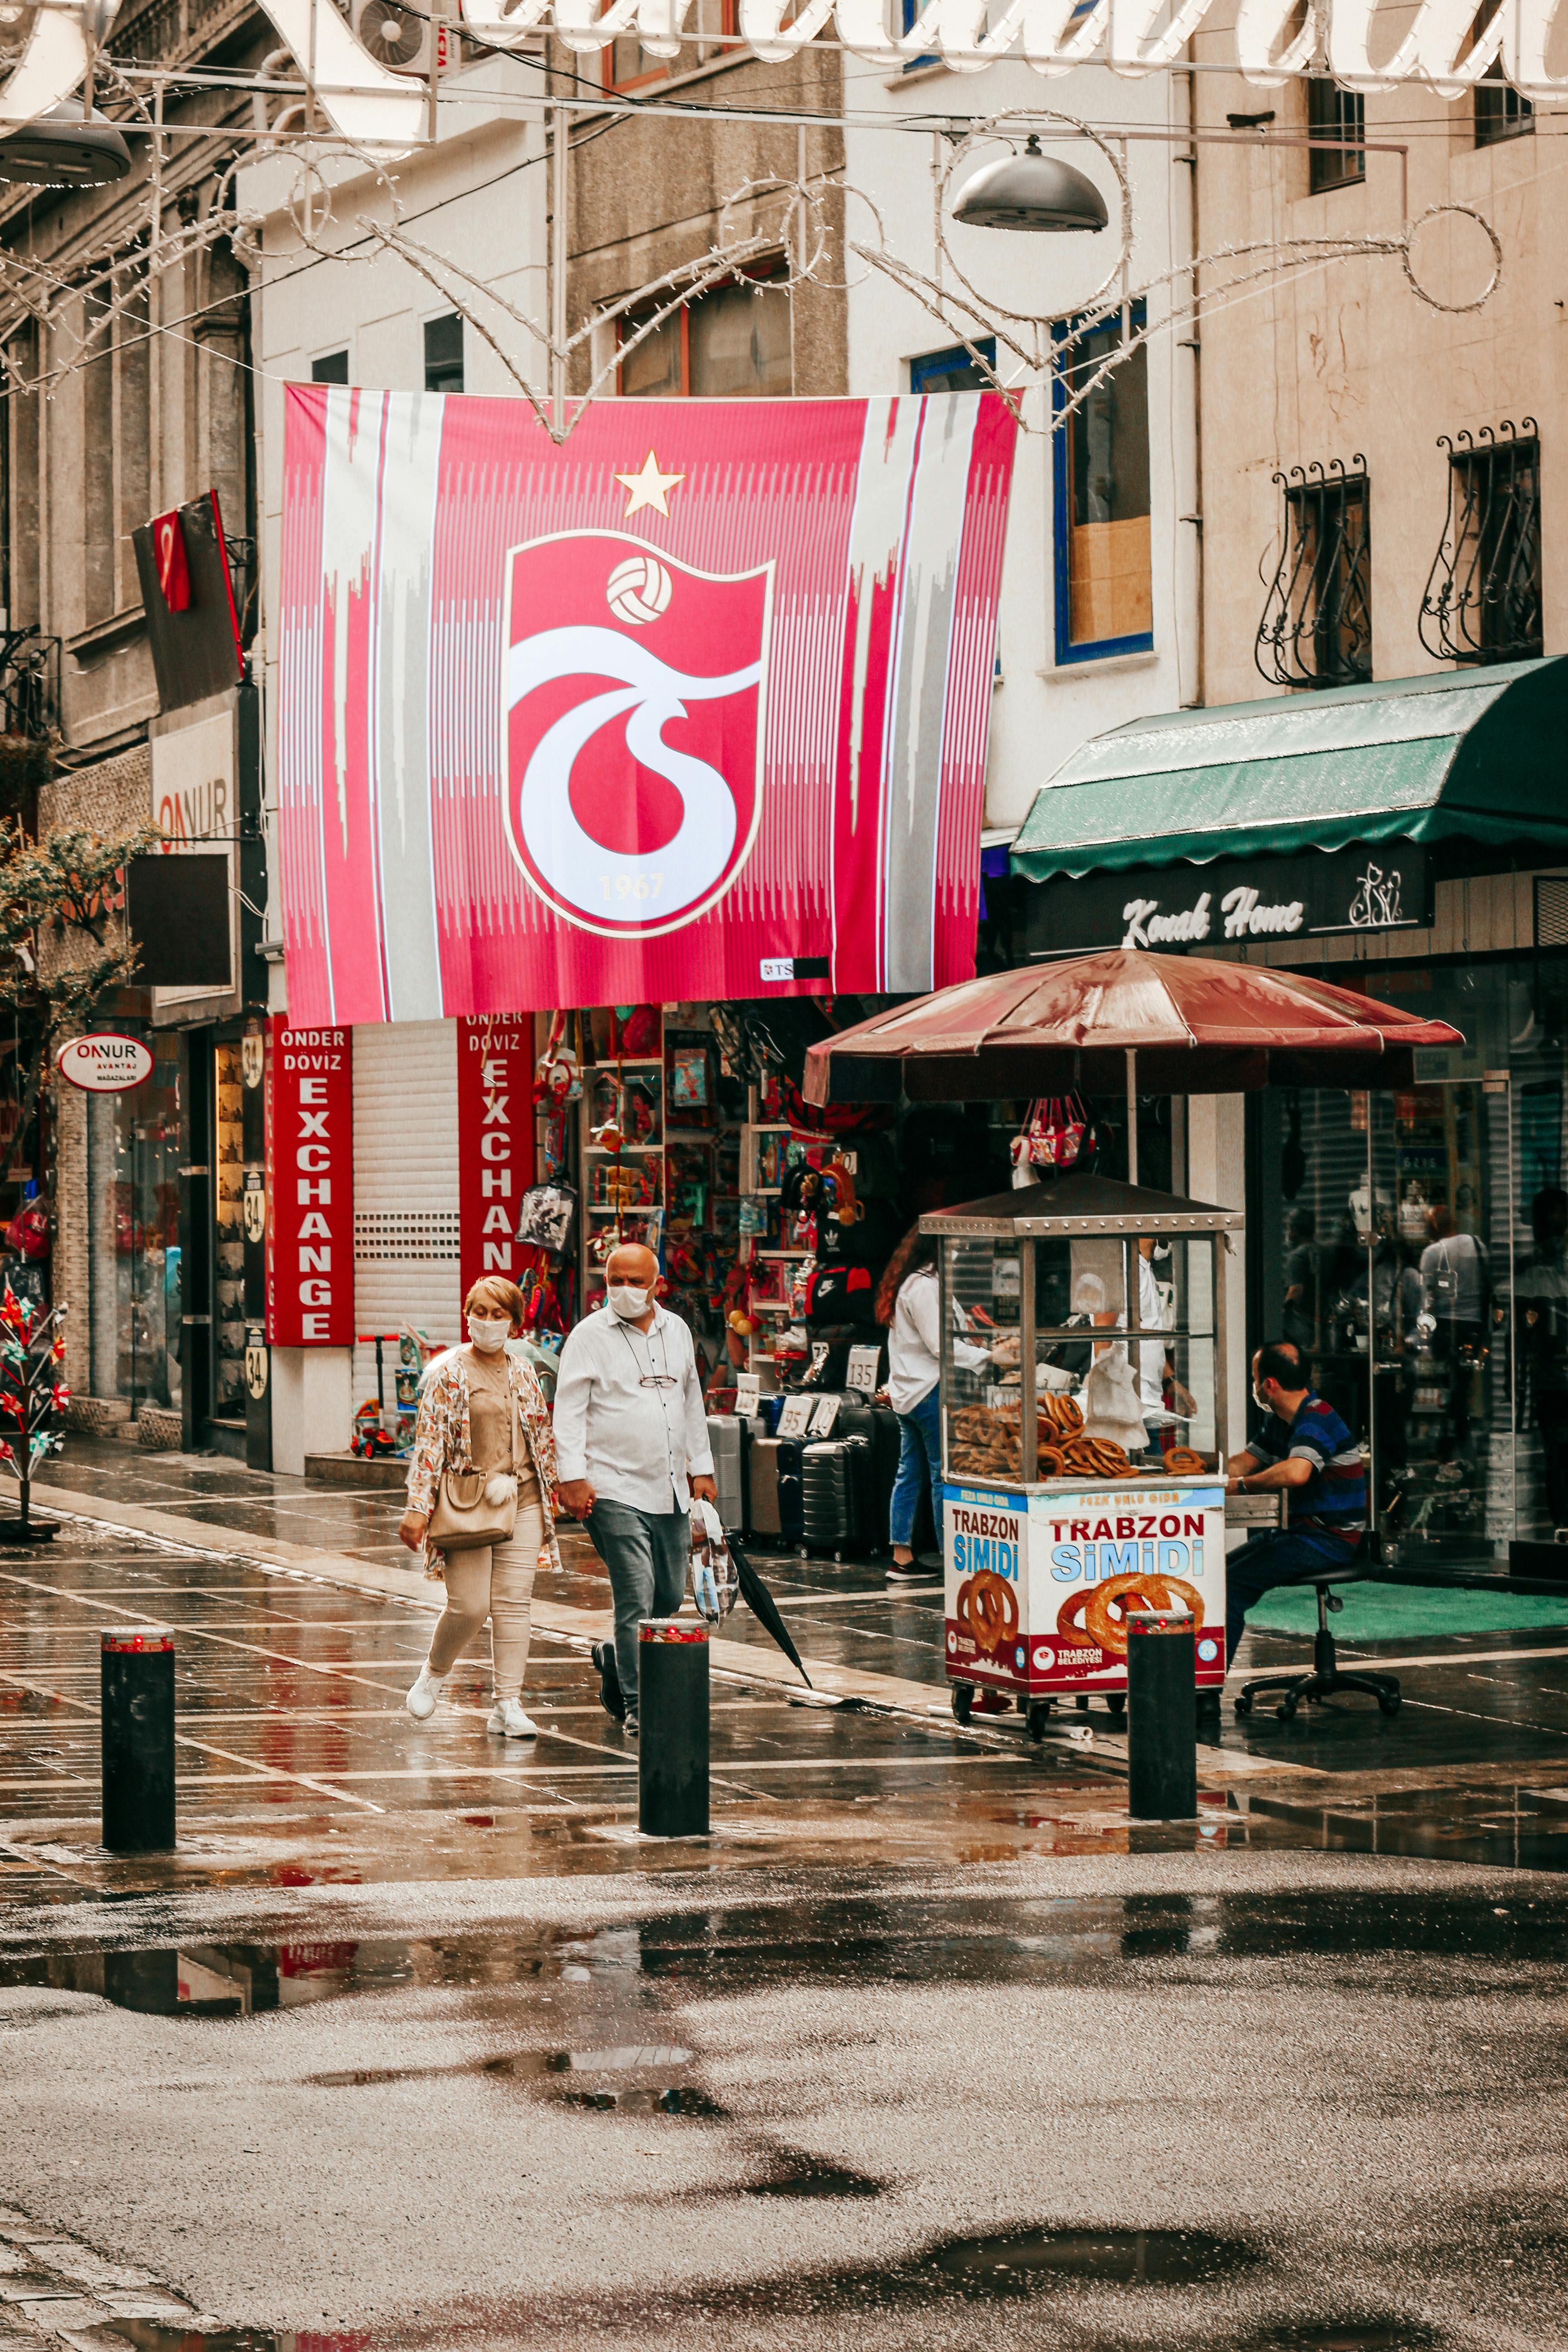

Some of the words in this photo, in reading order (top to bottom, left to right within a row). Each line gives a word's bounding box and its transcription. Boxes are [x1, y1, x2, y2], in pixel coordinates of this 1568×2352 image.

[599, 872, 665, 901] 1967
[1122, 892, 1211, 948] Konak
[1220, 886, 1303, 939] Home
[281, 1027, 345, 1047] ÖNDER
[77, 1044, 137, 1058] ONUR
[284, 1050, 342, 1070] DÖVİZ
[296, 1077, 333, 1339] EXCHANGE
[248, 1351, 261, 1390] 34
[848, 1364, 872, 1385] 135
[1080, 1495, 1109, 1506] FEZA
[1114, 1494, 1144, 1505] UNLU
[1148, 1492, 1180, 1504] GIDA
[952, 1509, 1019, 1541] TRABZON
[1049, 1514, 1204, 1542] TRABZON
[1057, 1648, 1102, 1658] TRABZON
